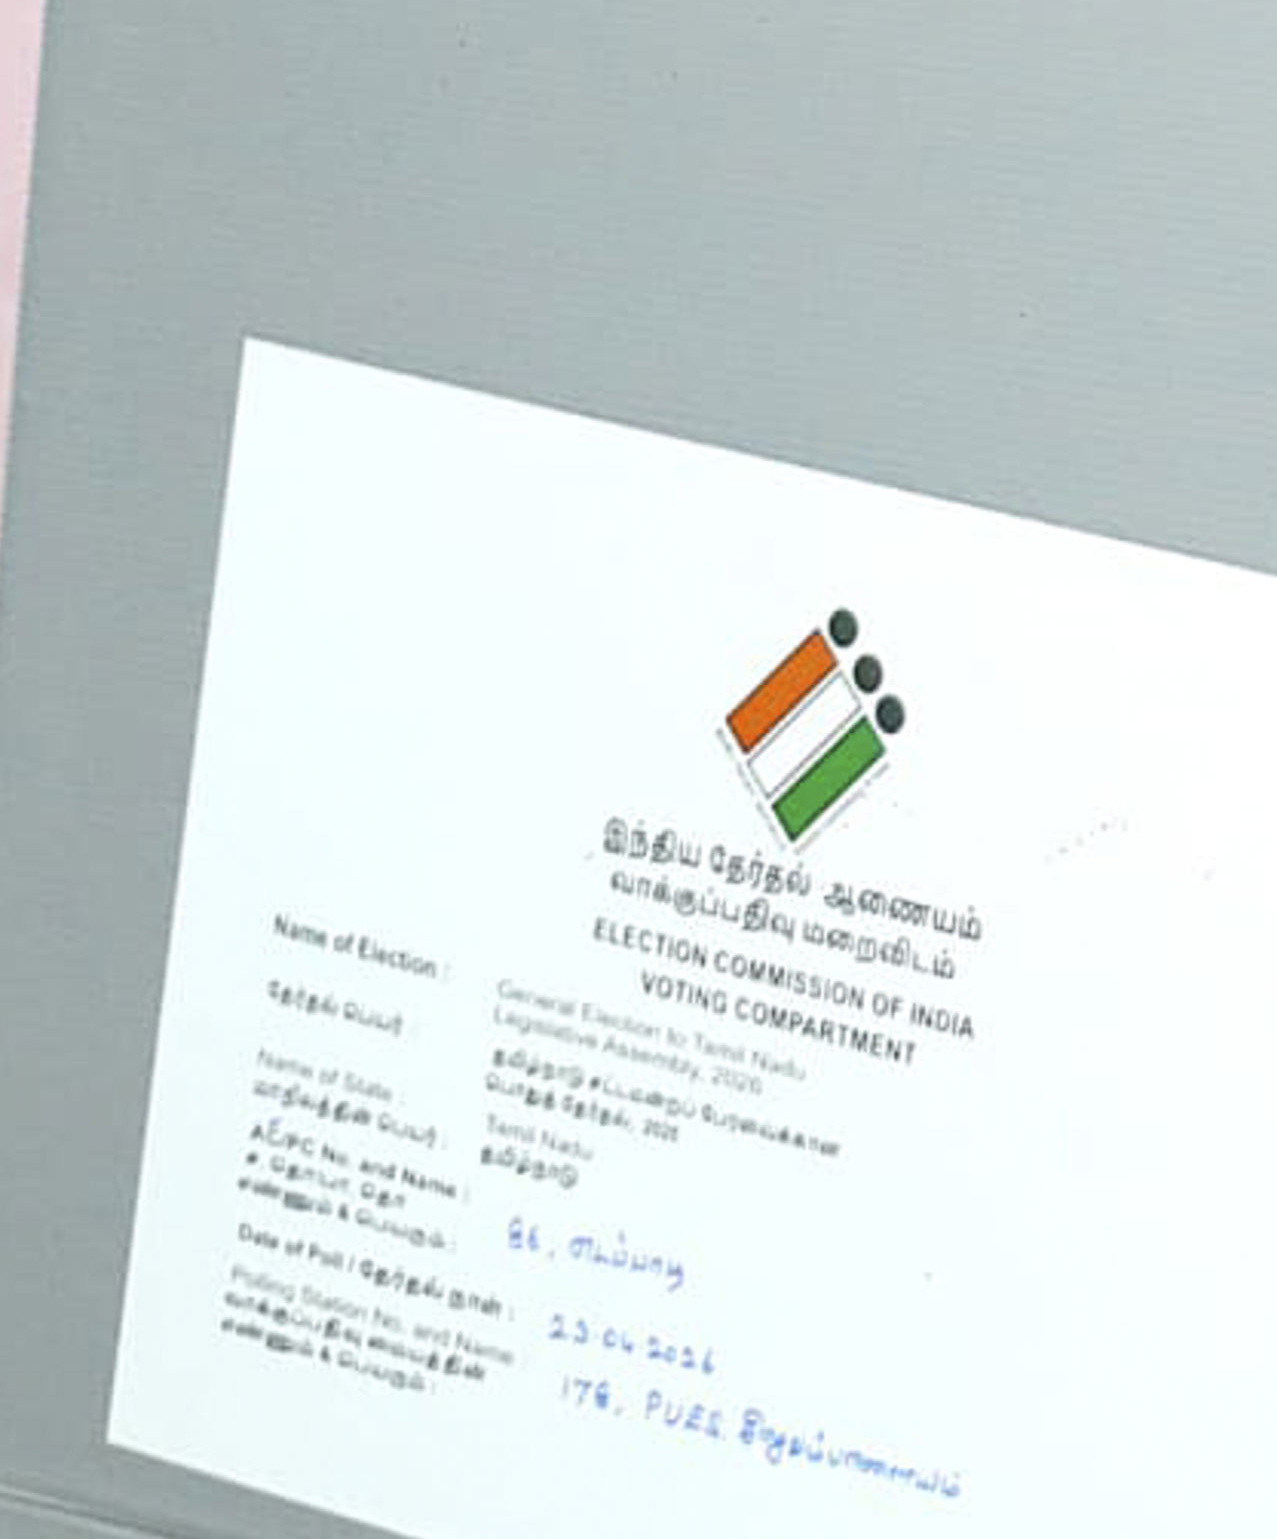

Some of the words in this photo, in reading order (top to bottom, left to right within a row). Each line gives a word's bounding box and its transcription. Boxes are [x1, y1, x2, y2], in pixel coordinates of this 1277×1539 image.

[603, 817, 701, 868] இந்திய
[709, 845, 811, 900] தேர்தல்
[823, 883, 981, 941] ஆணையம்
[274, 914, 327, 948] Name
[333, 933, 357, 958] of
[358, 936, 436, 978] Election
[610, 871, 795, 943] வாக்குப்பதிவு
[802, 922, 955, 979] மறைவிடம்
[593, 917, 708, 968] ELECTION
[714, 950, 864, 1010] COMMISSION
[872, 993, 903, 1019] OF
[910, 1003, 974, 1038] INDIA
[641, 970, 727, 1015] VOTING
[735, 997, 915, 1064] COMPARTMENT
[257, 1047, 313, 1079] Name
[343, 1071, 393, 1103] State
[359, 1159, 397, 1181] and
[401, 1167, 456, 1198] Name
[238, 1223, 279, 1249] Date
[285, 1240, 307, 1259] of
[305, 1243, 344, 1269] Poll
